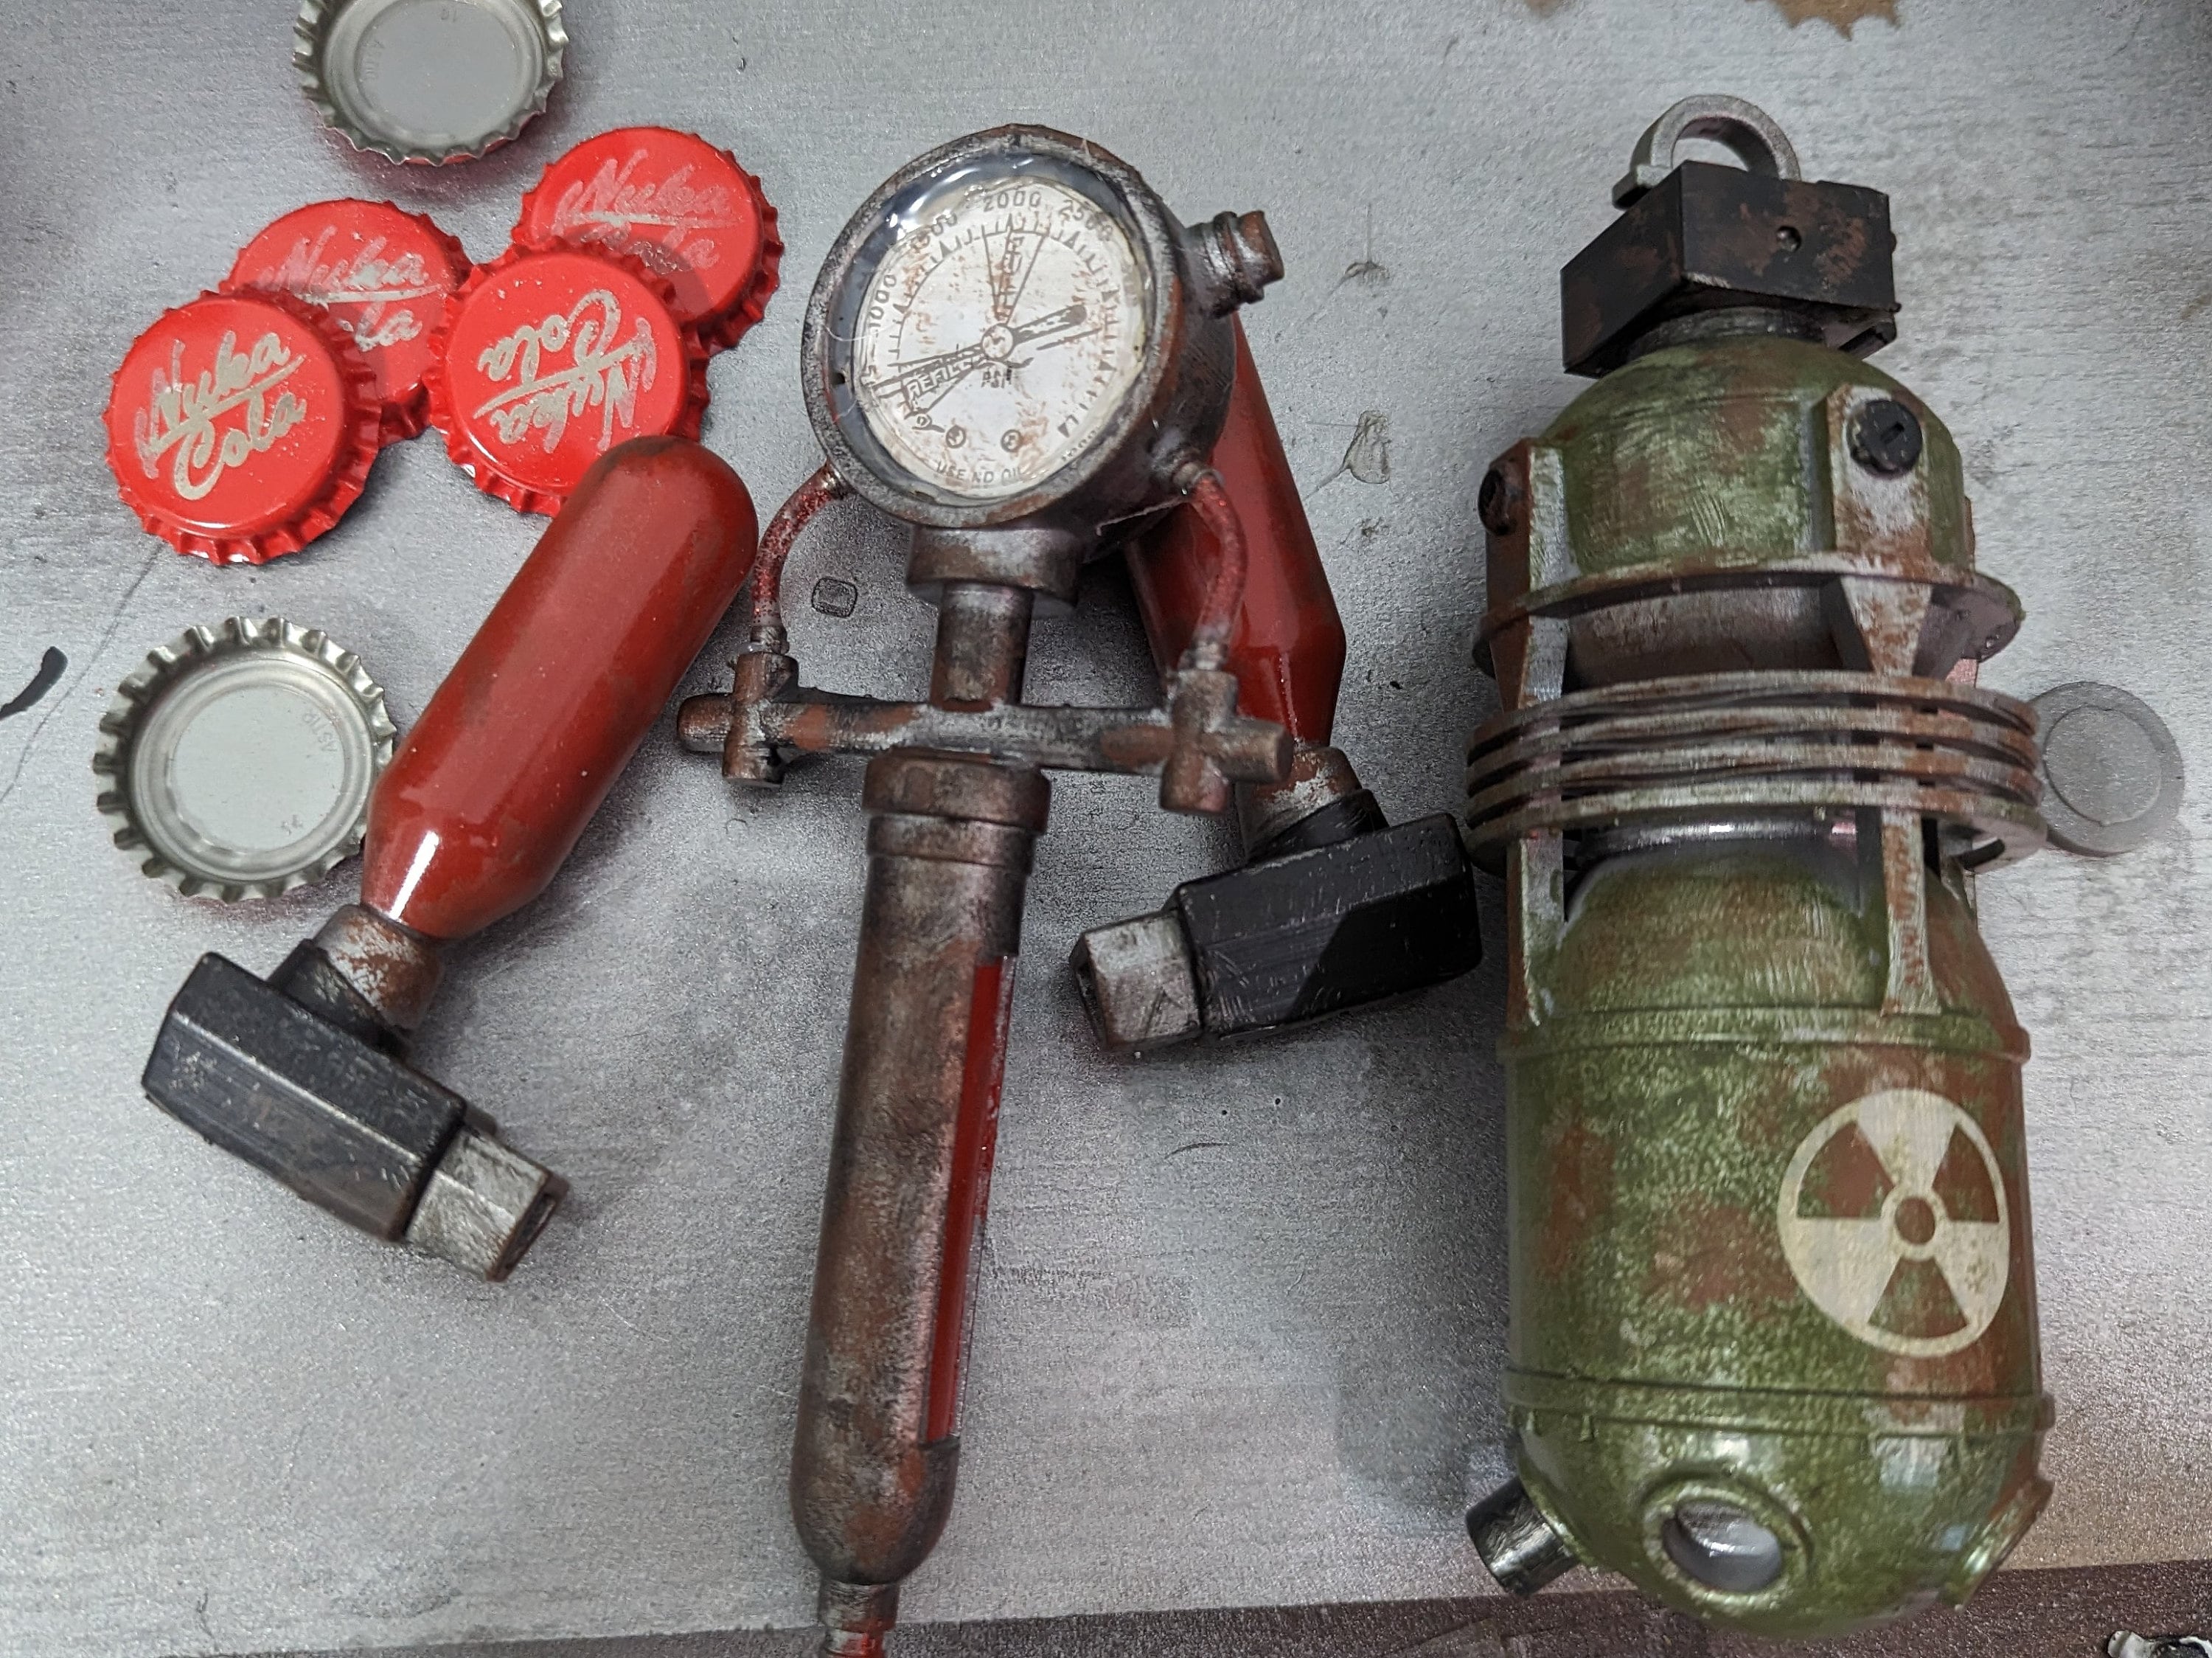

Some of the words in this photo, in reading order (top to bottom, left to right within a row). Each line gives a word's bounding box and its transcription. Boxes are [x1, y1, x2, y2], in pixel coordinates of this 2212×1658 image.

[984, 190, 1042, 212] 2000
[478, 288, 622, 387] Cola
[869, 274, 897, 328] 1000
[133, 330, 299, 479] Nuka
[487, 317, 658, 454] Nuka
[174, 389, 307, 501] Cola
